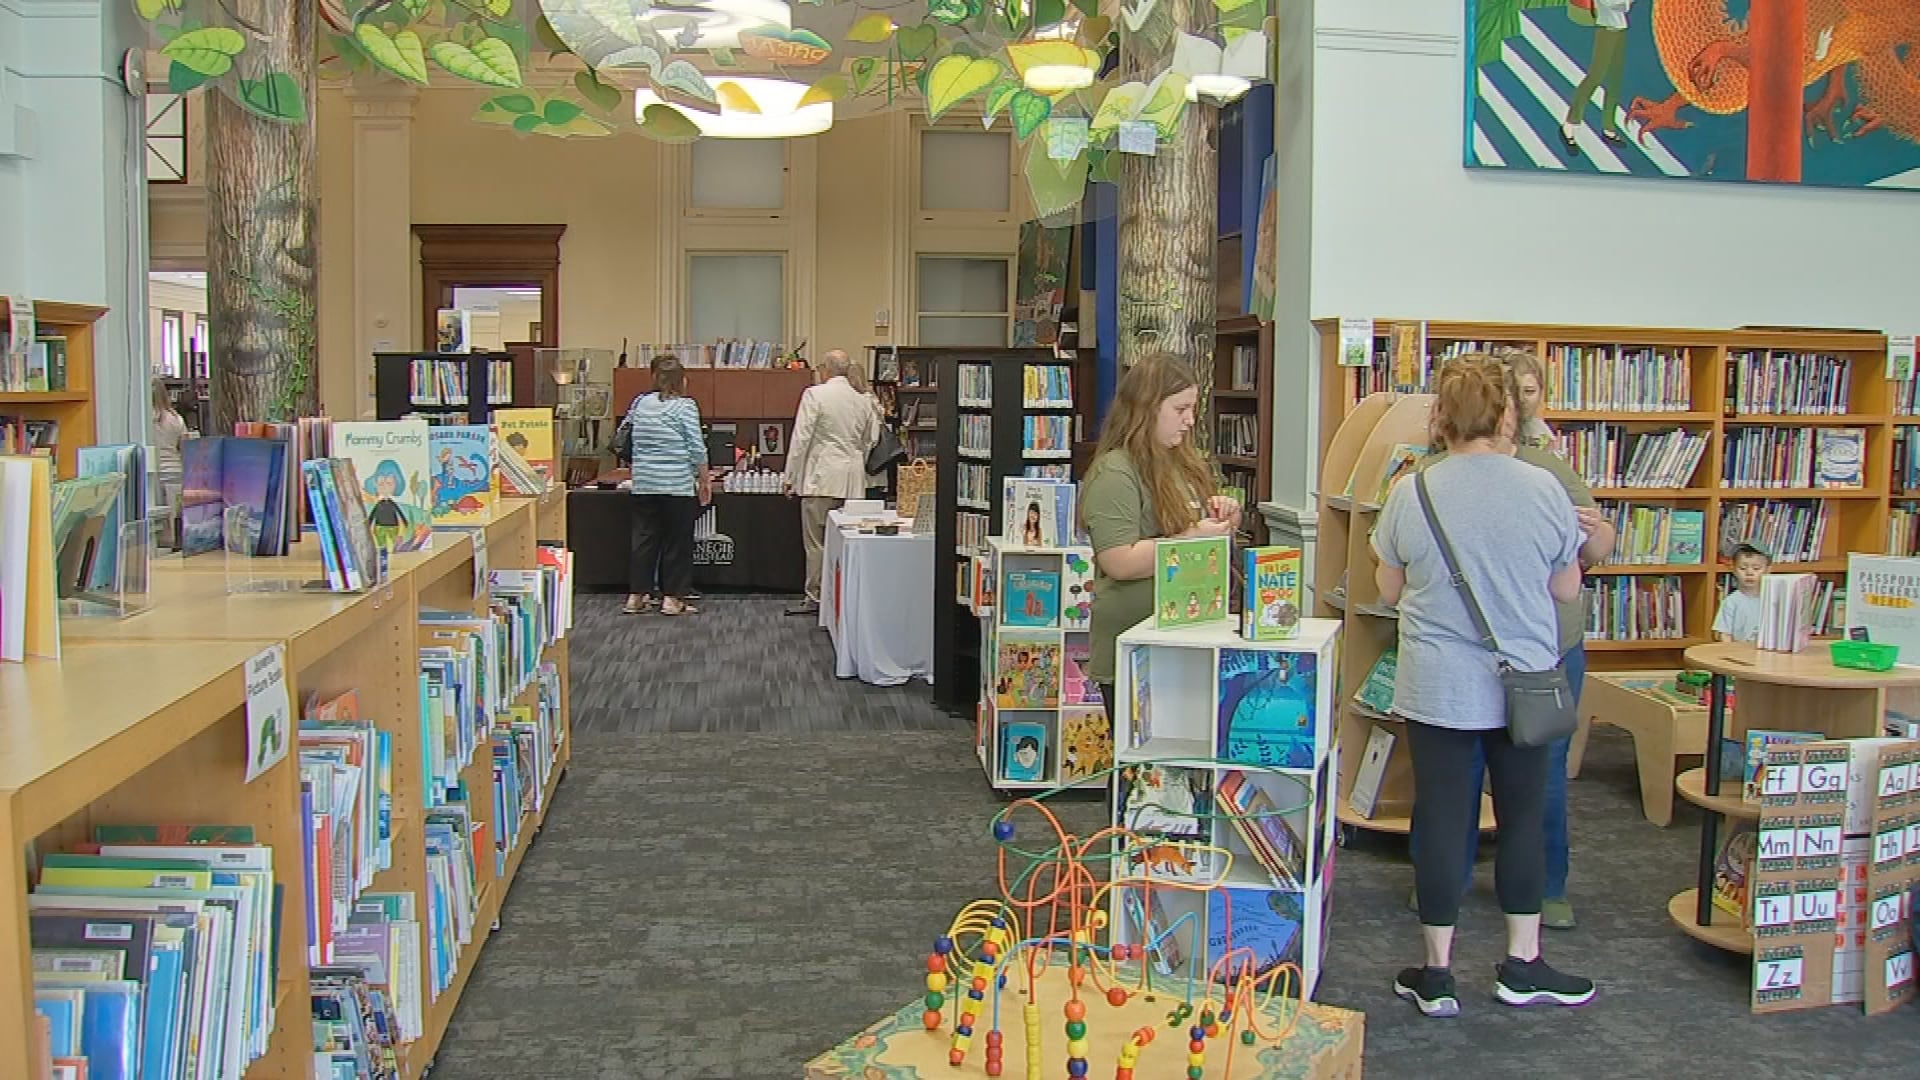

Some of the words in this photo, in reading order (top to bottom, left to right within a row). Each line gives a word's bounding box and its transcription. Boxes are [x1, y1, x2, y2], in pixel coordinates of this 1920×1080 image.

[692, 542, 735, 553] NEGIE
[1258, 572, 1297, 588] NATE
[1859, 583, 1919, 599] STICKERS
[1764, 767, 1787, 791] Ff
[1808, 765, 1841, 791] Gg
[1884, 771, 1905, 794] Aa
[1803, 830, 1833, 853] Nn
[1880, 836, 1898, 859] Hh
[1759, 899, 1780, 923] Tt
[1801, 895, 1828, 917] Uu
[1876, 901, 1897, 924] Oo
[1766, 963, 1793, 987] Zz
[1891, 957, 1909, 979] Vv
